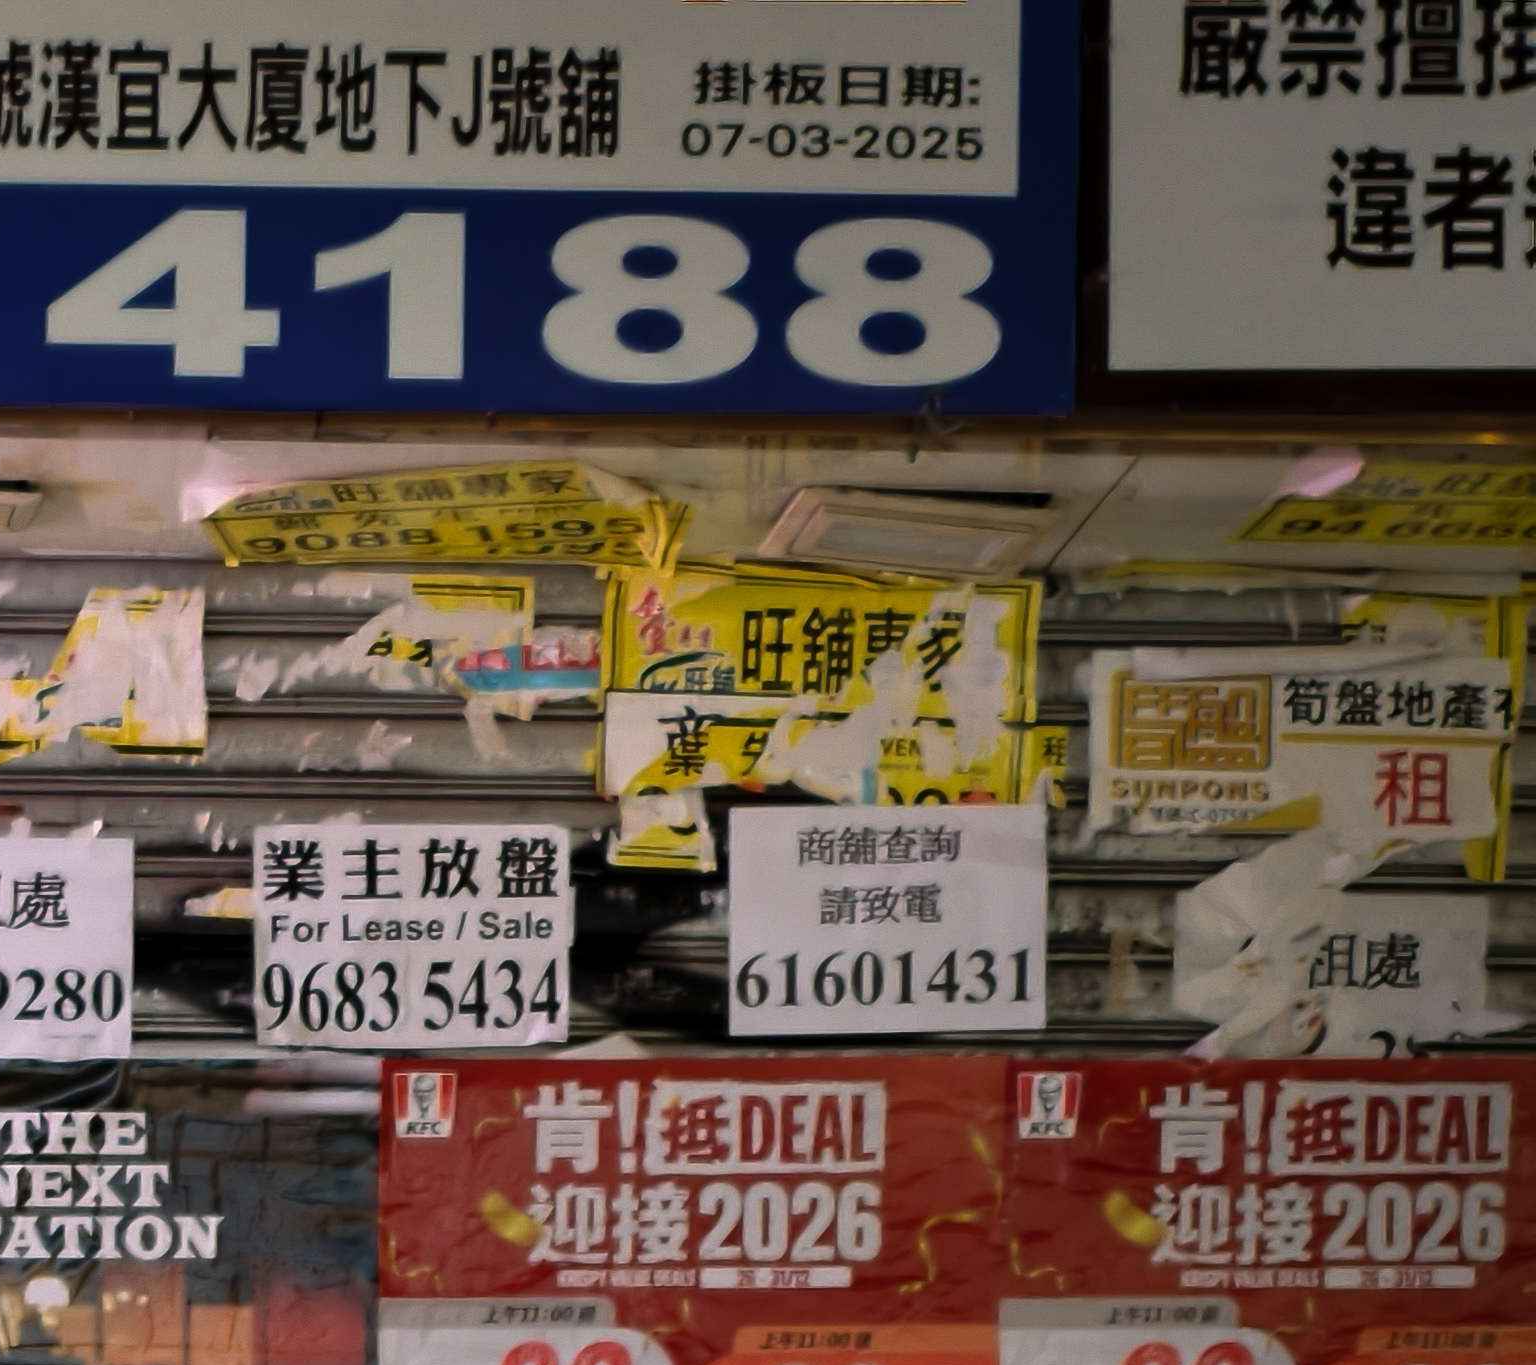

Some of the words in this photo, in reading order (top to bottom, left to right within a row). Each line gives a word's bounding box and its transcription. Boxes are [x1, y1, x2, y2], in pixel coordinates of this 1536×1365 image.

[694, 62, 981, 109] 掛板日期:
[681, 123, 984, 161] 07-03-2025
[1325, 146, 1536, 271] 違者
[46, 208, 1002, 387] 4188
[1375, 750, 1451, 826] 租
[263, 838, 561, 901] 業主放盤
[270, 914, 324, 943] For
[343, 913, 445, 942] Lease
[478, 911, 553, 941] Sale
[819, 886, 942, 926] 請致電
[263, 961, 400, 1035] 9683
[422, 958, 562, 1031] 5434
[736, 948, 1033, 1009] 61601431
[404, 1121, 441, 1135] KFC
[1027, 1122, 1067, 1136] KFC
